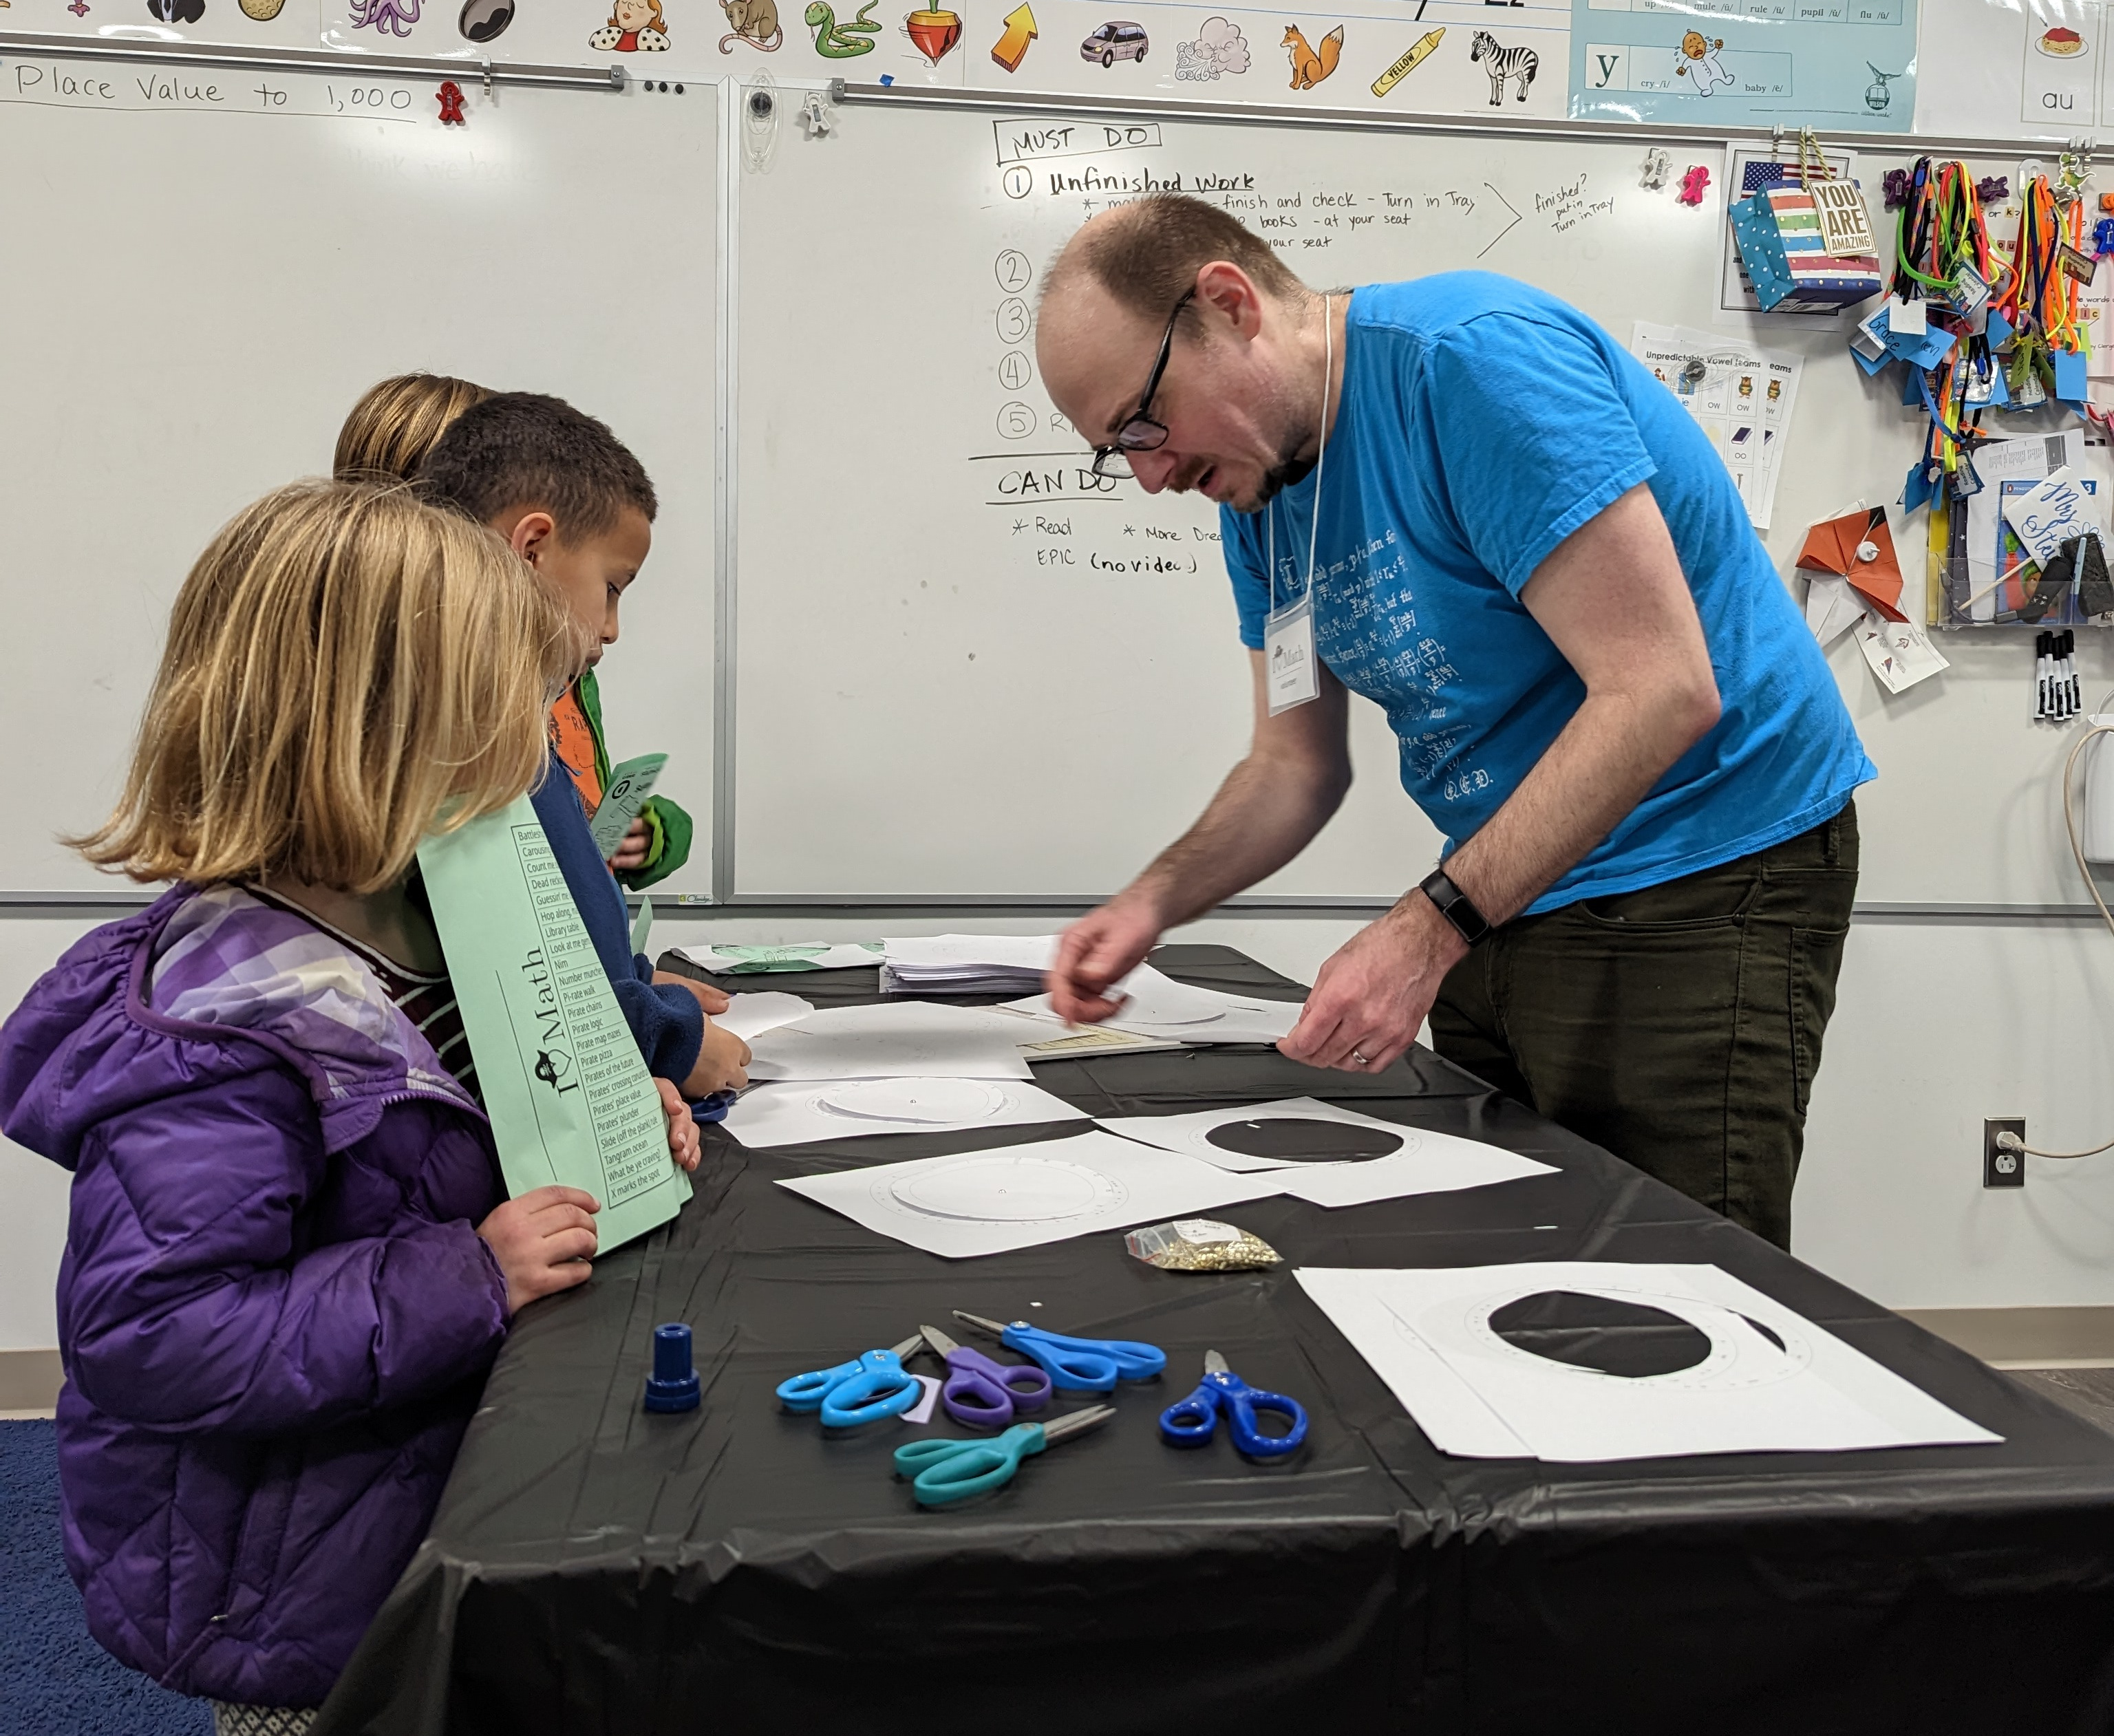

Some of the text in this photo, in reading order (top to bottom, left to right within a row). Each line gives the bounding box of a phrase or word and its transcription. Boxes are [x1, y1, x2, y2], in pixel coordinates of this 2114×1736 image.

[1801, 8, 1824, 17] pupil
[1860, 10, 1872, 19] flu
[1387, 52, 1415, 79] YELLOW
[1595, 54, 1619, 88] y
[15, 65, 412, 112] Place Value to 1,000
[1641, 80, 1654, 89] cry
[1745, 84, 1766, 93] baby
[2042, 93, 2073, 110] au
[1012, 127, 1148, 158] MUST DO
[1050, 167, 1182, 196] Unfinished
[1195, 173, 1254, 193] Work
[1277, 192, 1301, 208] and
[1313, 192, 1357, 208] check
[1382, 192, 1413, 208] Turn
[1424, 192, 1440, 208] in
[1445, 191, 1477, 215] Tray
[1535, 173, 1587, 213] finished?
[1815, 184, 1858, 208] YOU
[1551, 219, 1575, 233] Turn
[1589, 197, 1613, 214] Tray
[1556, 200, 1583, 221] put in
[1260, 215, 1297, 228] books
[1349, 214, 1375, 231] your
[1384, 215, 1411, 226] seat
[1826, 208, 1867, 237] ARE
[1303, 236, 1332, 248] seat
[1831, 235, 1870, 251] AMAZING
[1869, 314, 1900, 351] Grace
[1707, 357, 1733, 366] Vowel
[1769, 362, 1792, 374] eams
[999, 470, 1063, 495] CAN
[1036, 517, 1072, 536] Read
[1145, 526, 1182, 542] More
[1038, 548, 1076, 565] EPIC
[1090, 553, 1126, 572] (no
[526, 861, 547, 873] Count
[531, 877, 549, 889] Dead
[540, 912, 555, 921] Hop
[545, 925, 567, 937] Library
[549, 940, 581, 954] Look at me
[554, 959, 568, 970] Nim
[558, 972, 584, 986] Number
[521, 945, 566, 1045] Math
[563, 984, 596, 1003] Pi-rate walk
[568, 1000, 603, 1019] Pirate chains
[572, 1017, 604, 1035] Pirate logic
[576, 1039, 594, 1051] Pirate
[594, 1033, 608, 1045] map
[580, 1048, 613, 1067] Pirate pizza
[584, 1058, 634, 1084] Pirates of the future
[588, 1083, 611, 1100] Pirates'
[611, 1076, 633, 1091] crossing
[592, 1089, 642, 1116] Pirates' place value
[597, 1107, 639, 1133] Pirates' plunder
[601, 1136, 617, 1149] Slide
[617, 1129, 628, 1144] (off
[628, 1124, 637, 1135] the
[604, 1139, 649, 1166] Tangram ocean
[608, 1167, 626, 1182] What
[626, 1162, 634, 1172] be
[634, 1161, 642, 1172] ye
[611, 1168, 661, 1199] X marks the spot
